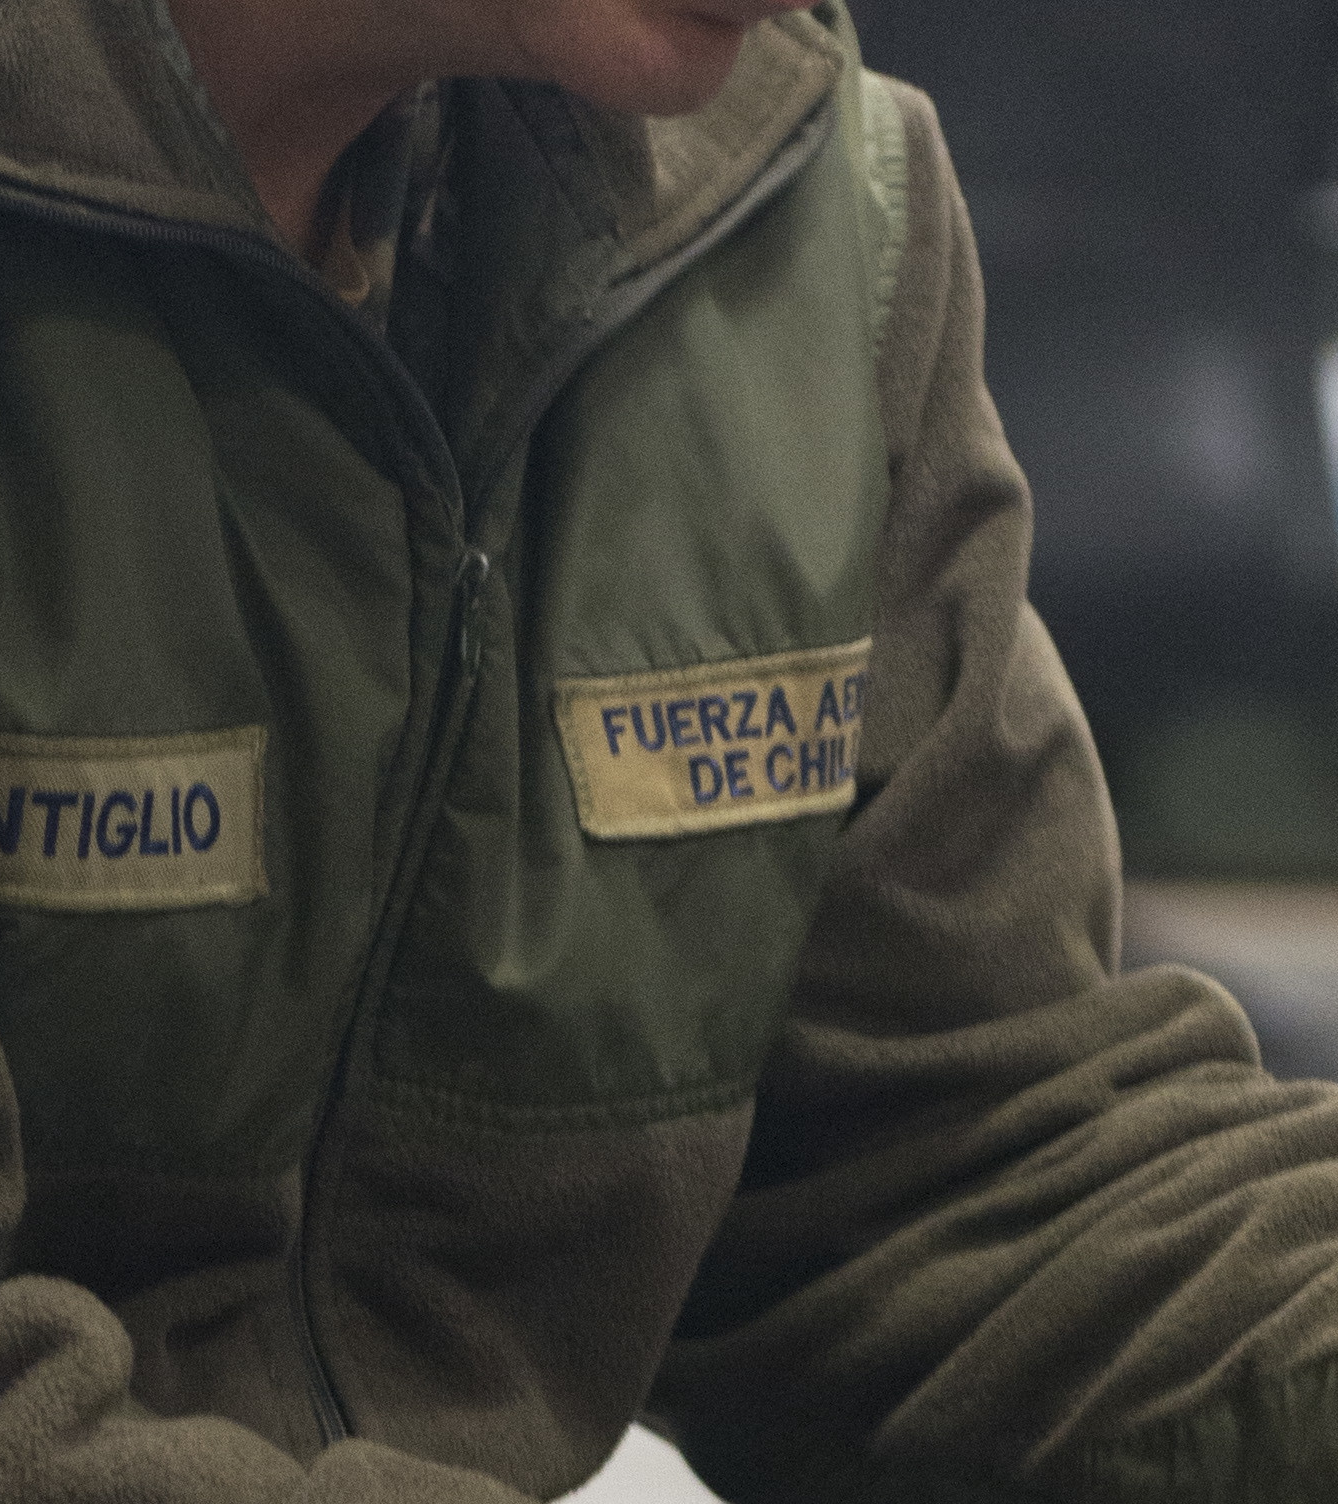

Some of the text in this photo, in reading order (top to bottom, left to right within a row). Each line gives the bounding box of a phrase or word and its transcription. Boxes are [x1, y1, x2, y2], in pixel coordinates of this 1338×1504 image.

[601, 671, 865, 756] FUERZA AE
[688, 733, 859, 805] DE CHIL
